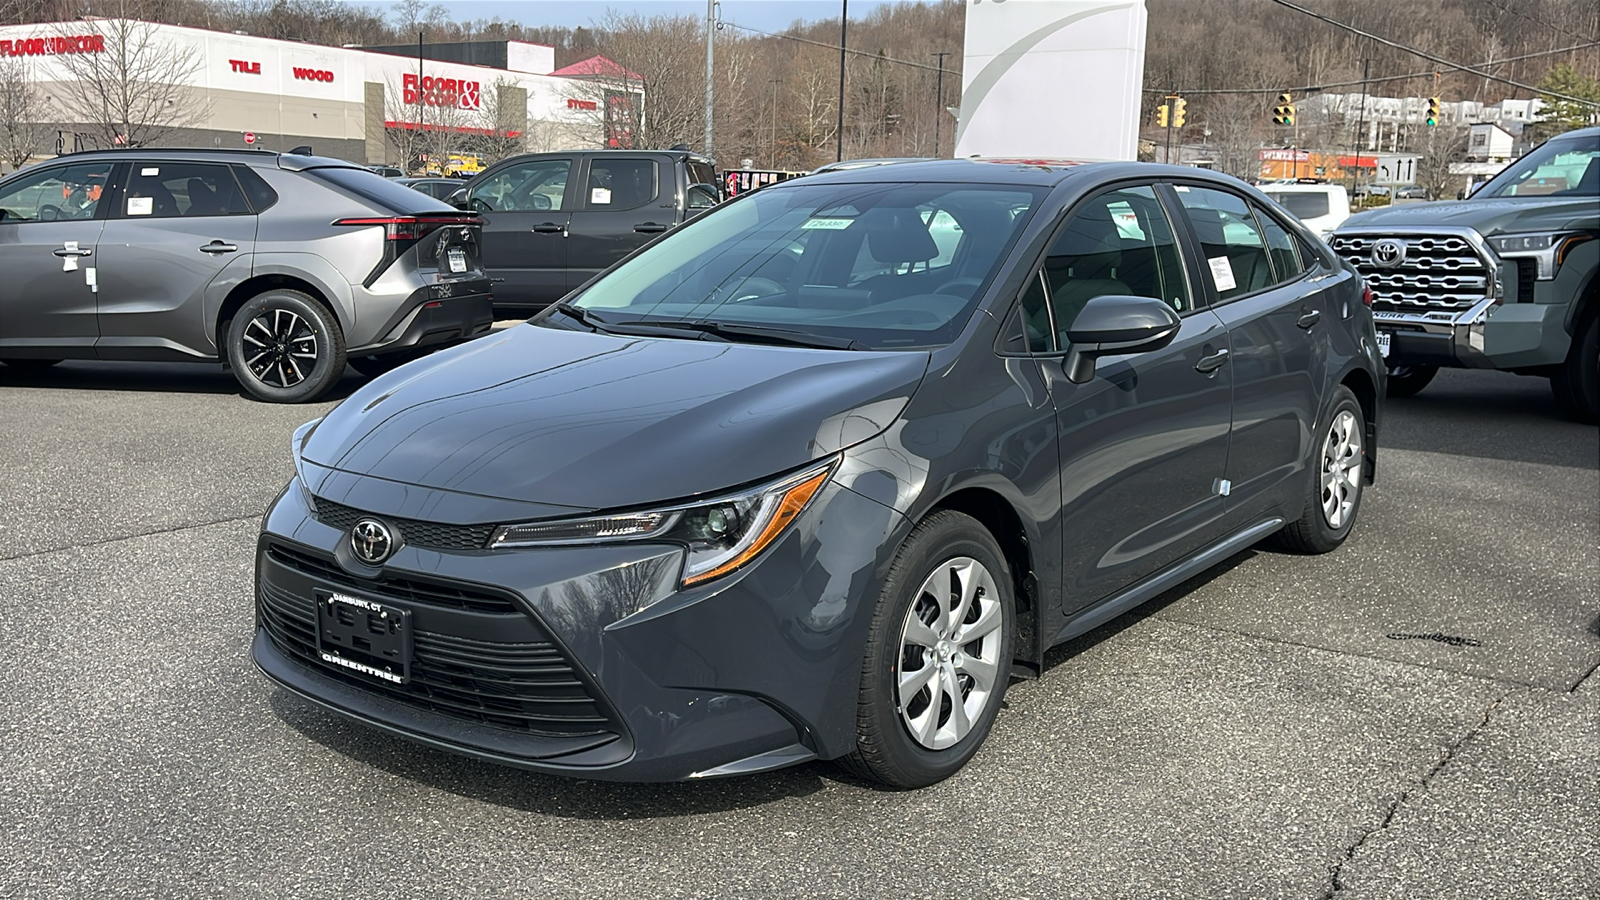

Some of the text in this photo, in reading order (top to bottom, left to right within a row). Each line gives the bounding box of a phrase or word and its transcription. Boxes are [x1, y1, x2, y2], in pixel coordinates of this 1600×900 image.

[228, 59, 261, 75] TILE
[292, 66, 335, 83] WOOD
[403, 73, 480, 111] FLOOR &
[403, 88, 457, 109] DECOR
[333, 593, 382, 612] DANBURY, CT
[322, 653, 402, 684] GREENTREE
